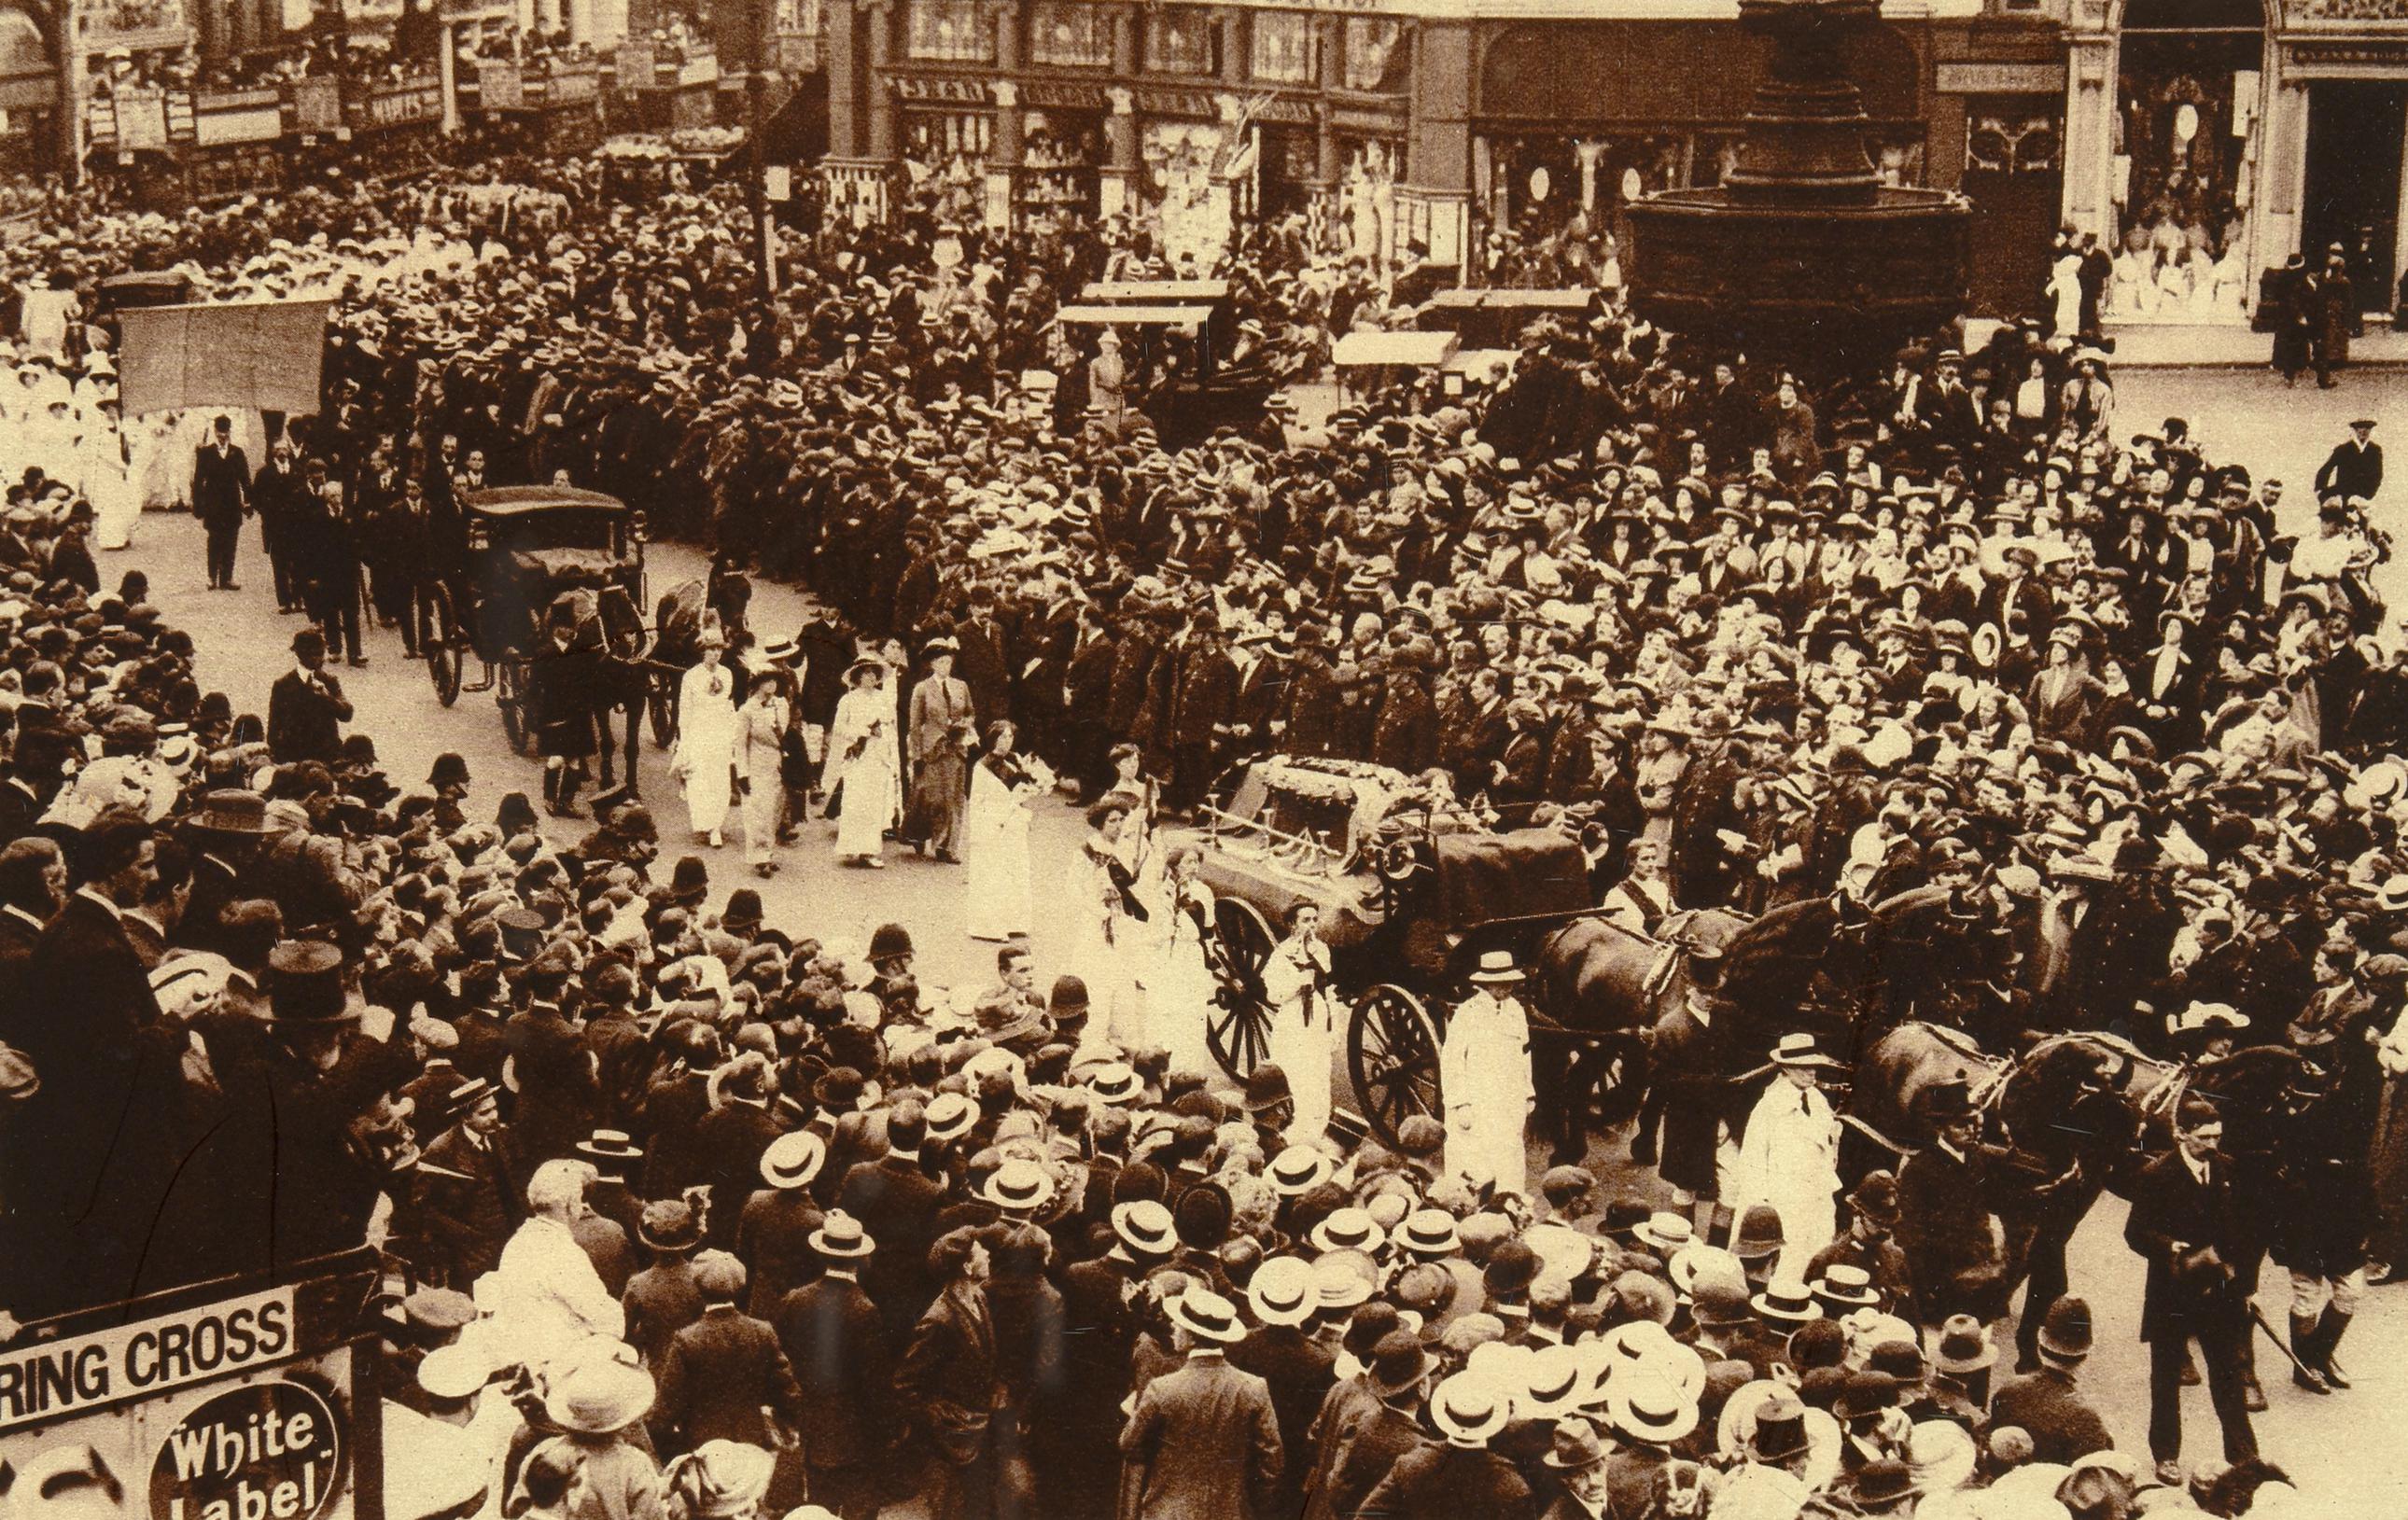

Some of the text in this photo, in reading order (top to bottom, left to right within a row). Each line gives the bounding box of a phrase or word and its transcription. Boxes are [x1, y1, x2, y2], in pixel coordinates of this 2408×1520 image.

[0, 1301, 287, 1417] RING CROSS
[171, 1410, 314, 1482] White
